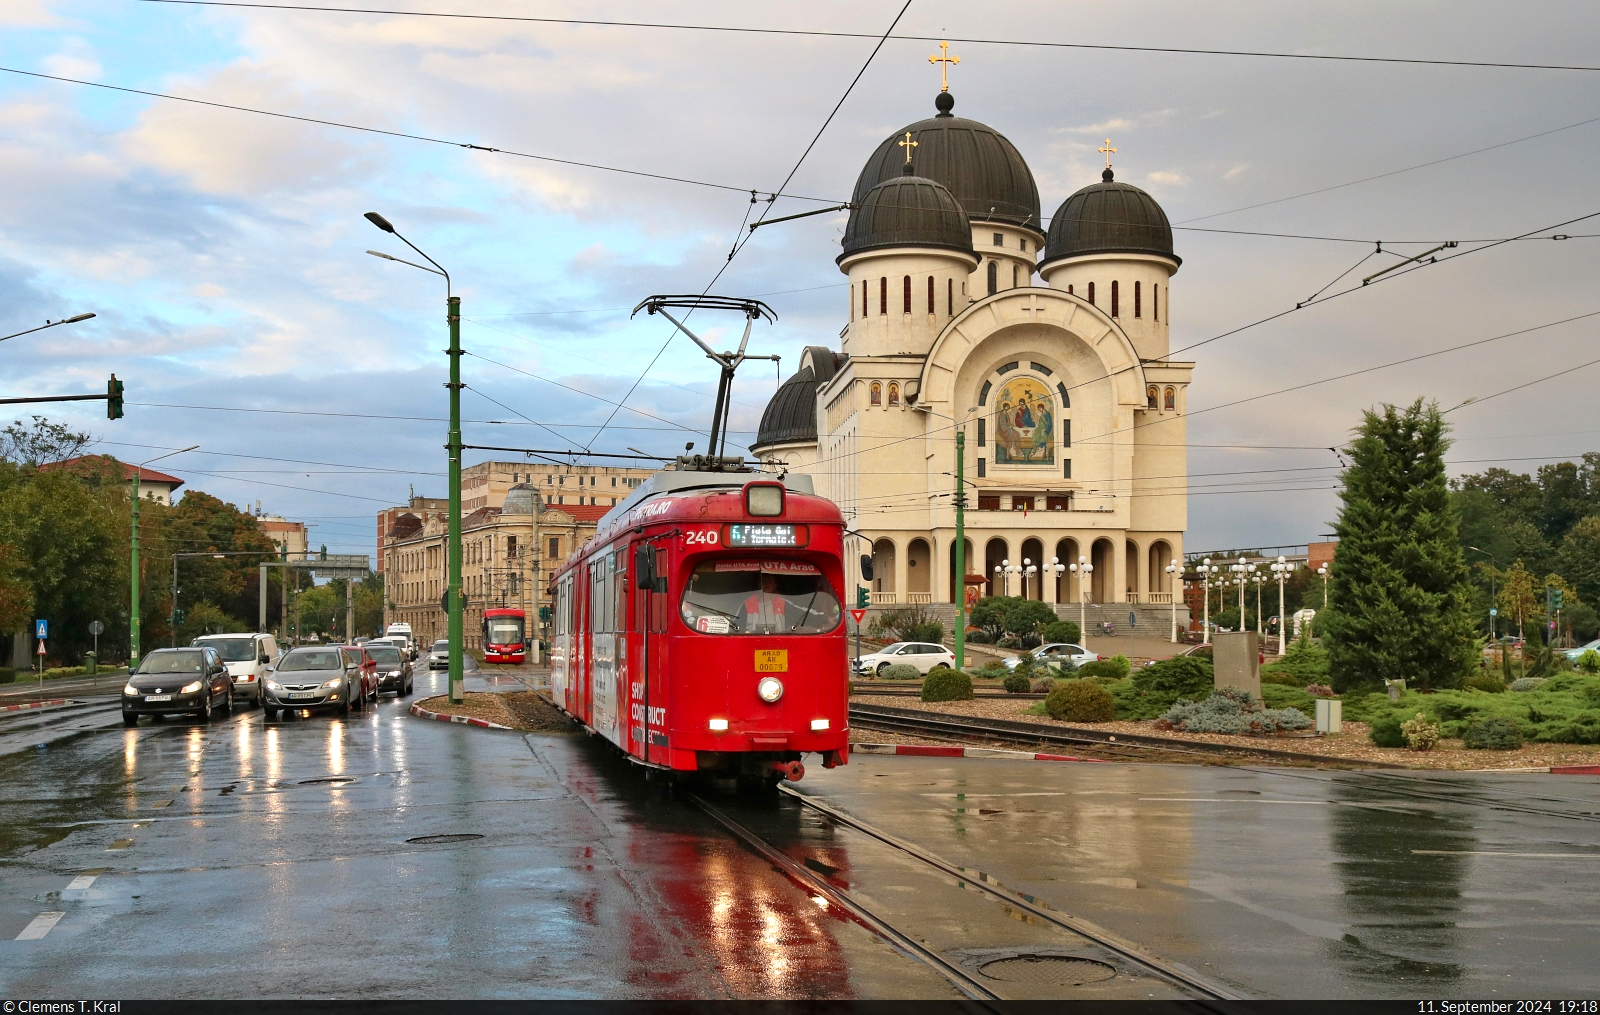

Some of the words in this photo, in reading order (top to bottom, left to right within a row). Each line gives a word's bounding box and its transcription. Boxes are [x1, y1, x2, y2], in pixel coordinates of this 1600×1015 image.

[686, 530, 718, 545] 240
[763, 561, 788, 570] UTA
[790, 563, 815, 572] Arad
[697, 617, 709, 632] 6
[759, 663, 783, 671] 00079
